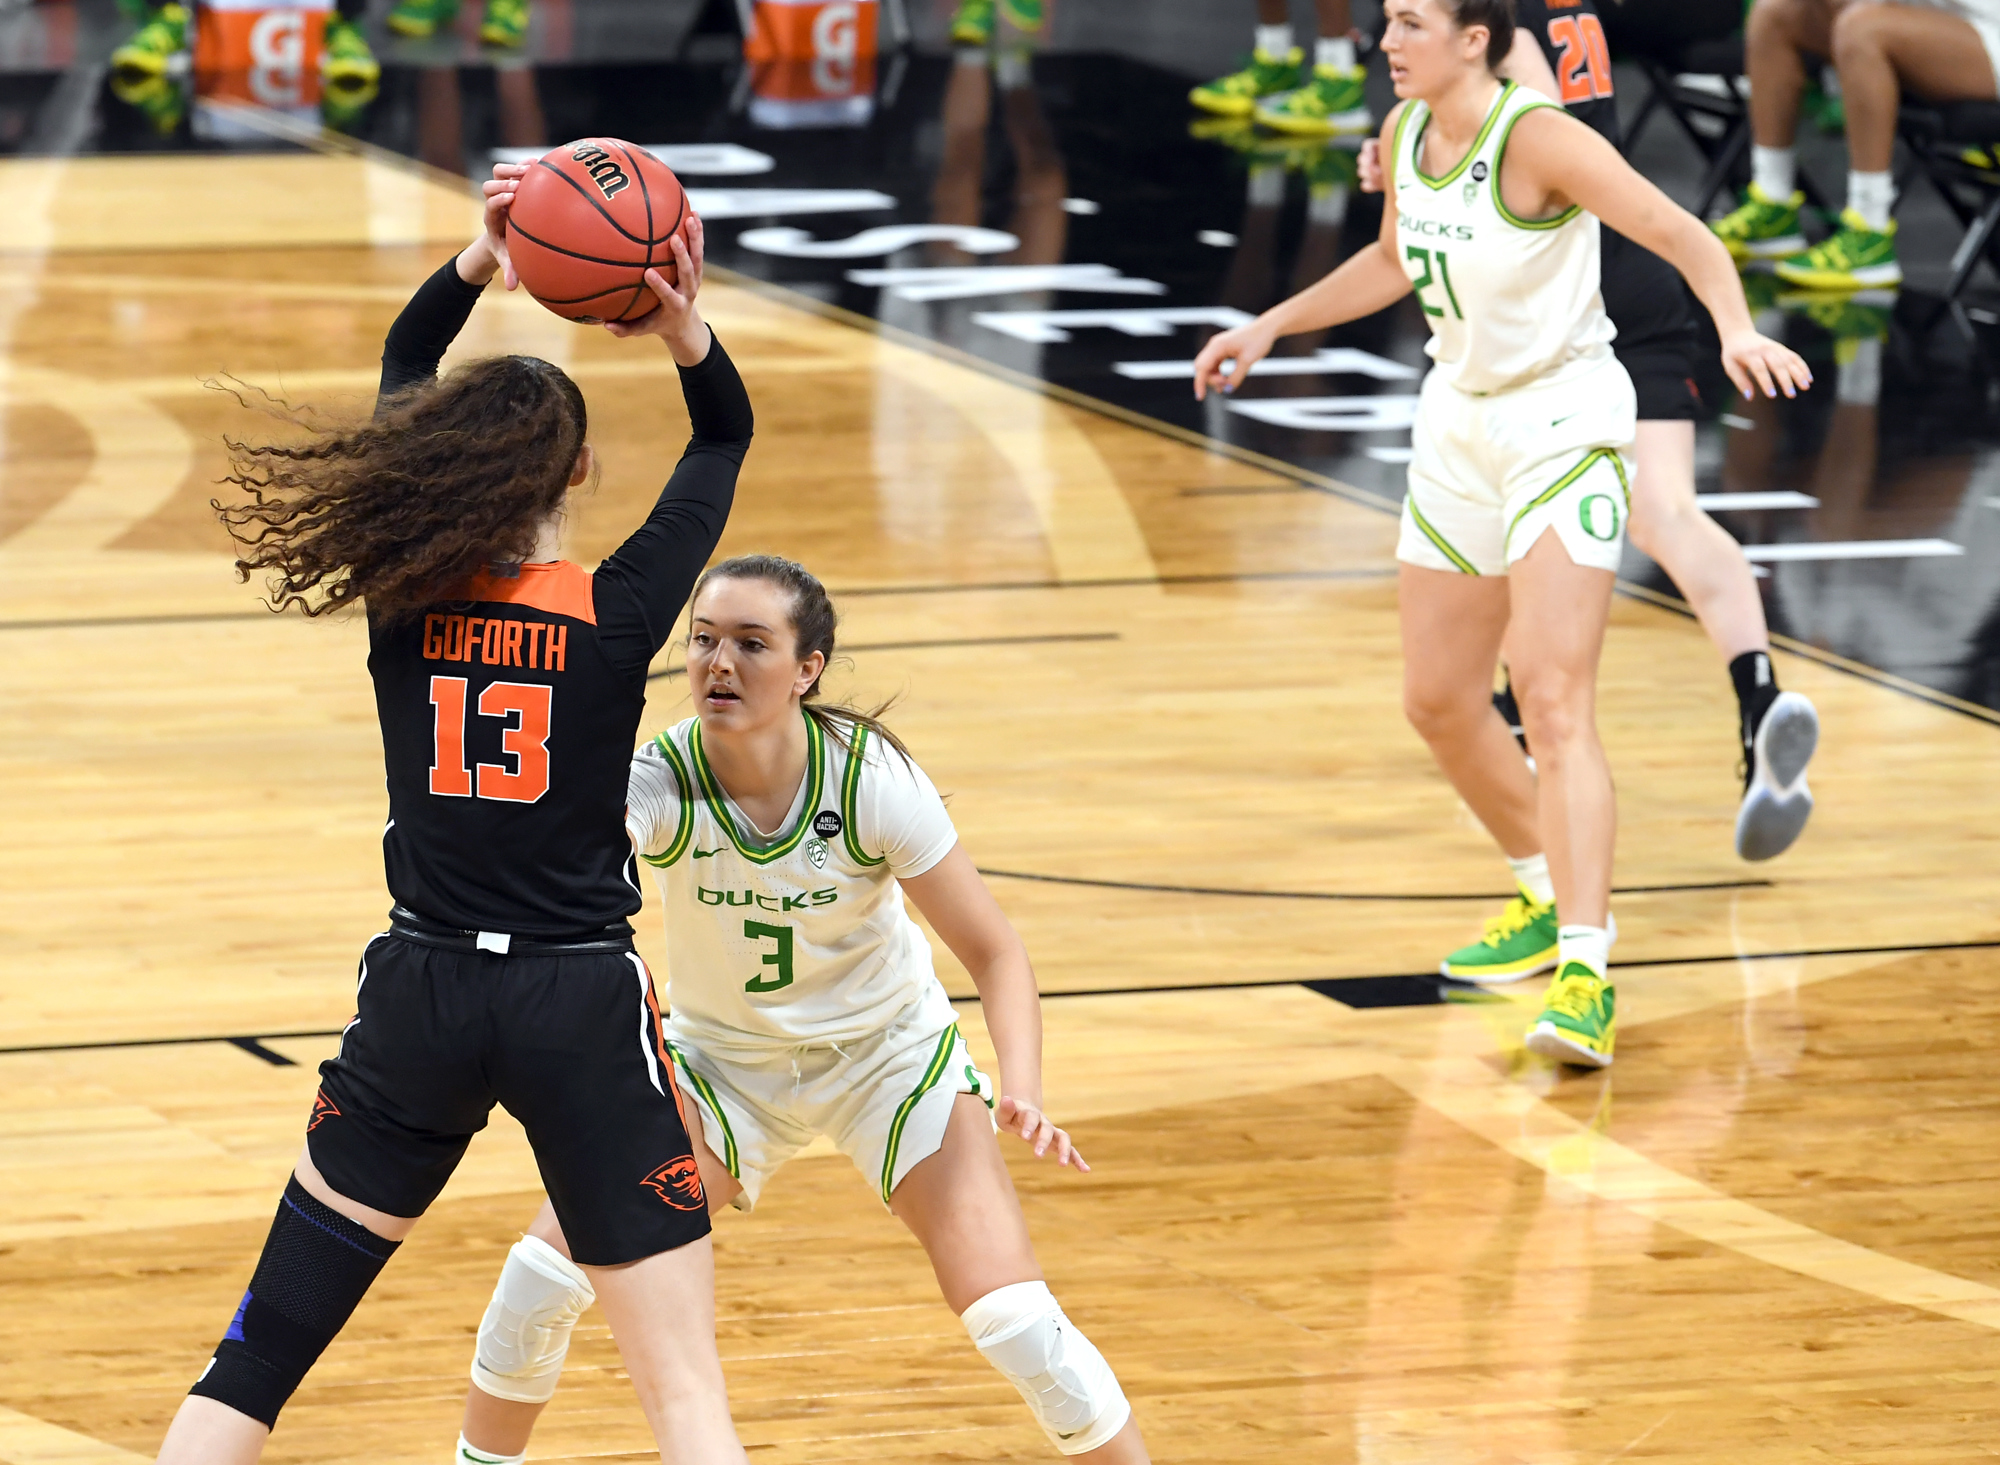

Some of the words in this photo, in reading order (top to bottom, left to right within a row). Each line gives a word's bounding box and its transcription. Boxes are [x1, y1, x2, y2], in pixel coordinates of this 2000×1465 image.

[1547, 12, 1614, 105] 20
[1398, 212, 1474, 241] DUCKS
[1406, 245, 1464, 320] 21
[423, 614, 567, 671] GOFORTH
[429, 675, 553, 804] 13
[816, 823, 839, 831] RACISM
[697, 885, 838, 912] DUCKS
[744, 920, 793, 992] 3
